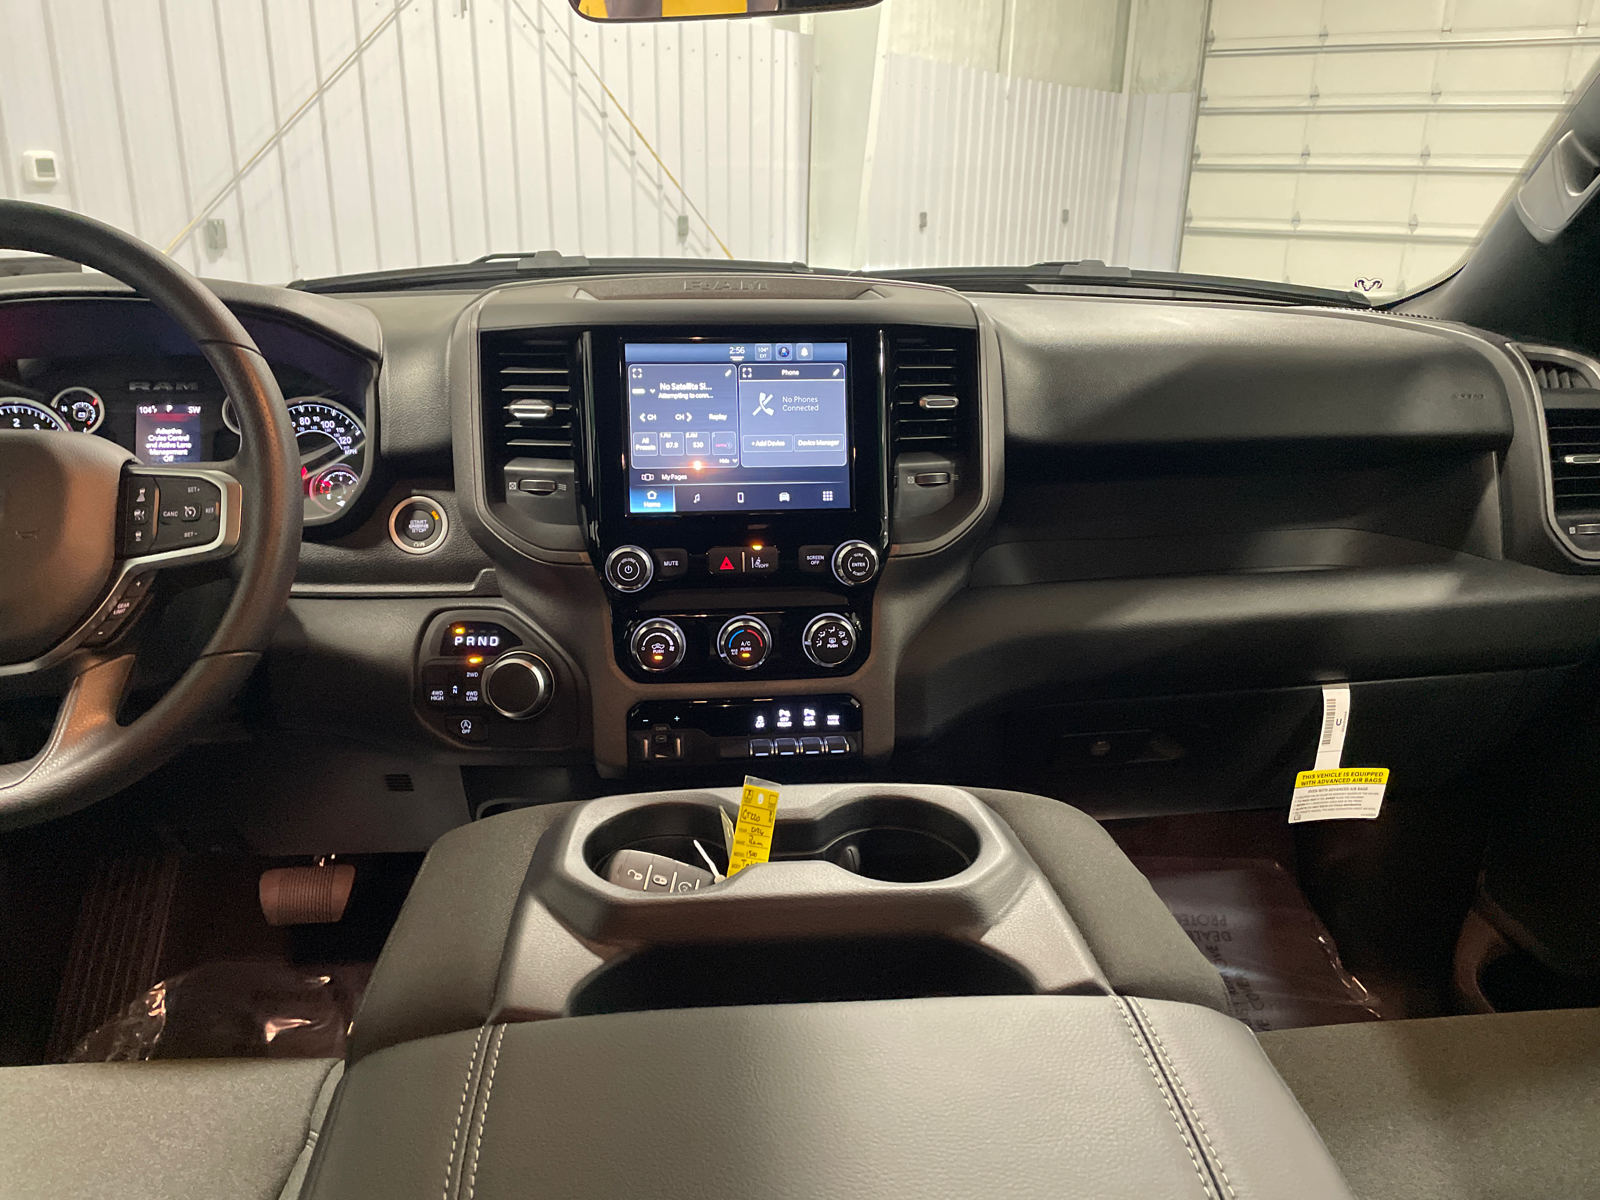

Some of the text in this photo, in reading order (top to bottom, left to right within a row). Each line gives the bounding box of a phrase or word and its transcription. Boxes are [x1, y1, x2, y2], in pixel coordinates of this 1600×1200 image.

[683, 280, 768, 291] RAM
[729, 346, 745, 355] 2:56
[128, 381, 199, 391] RAM
[659, 383, 671, 391] No
[671, 383, 698, 391] Satellite
[166, 404, 173, 413] P
[187, 406, 201, 414] SW
[299, 416, 311, 425] 80
[708, 413, 728, 421] Replay
[12, 418, 21, 428] 2
[320, 420, 335, 428] 100
[167, 434, 190, 442] Control
[339, 436, 352, 444] 120
[145, 441, 192, 449] and Active Lane
[816, 439, 840, 447] Manager
